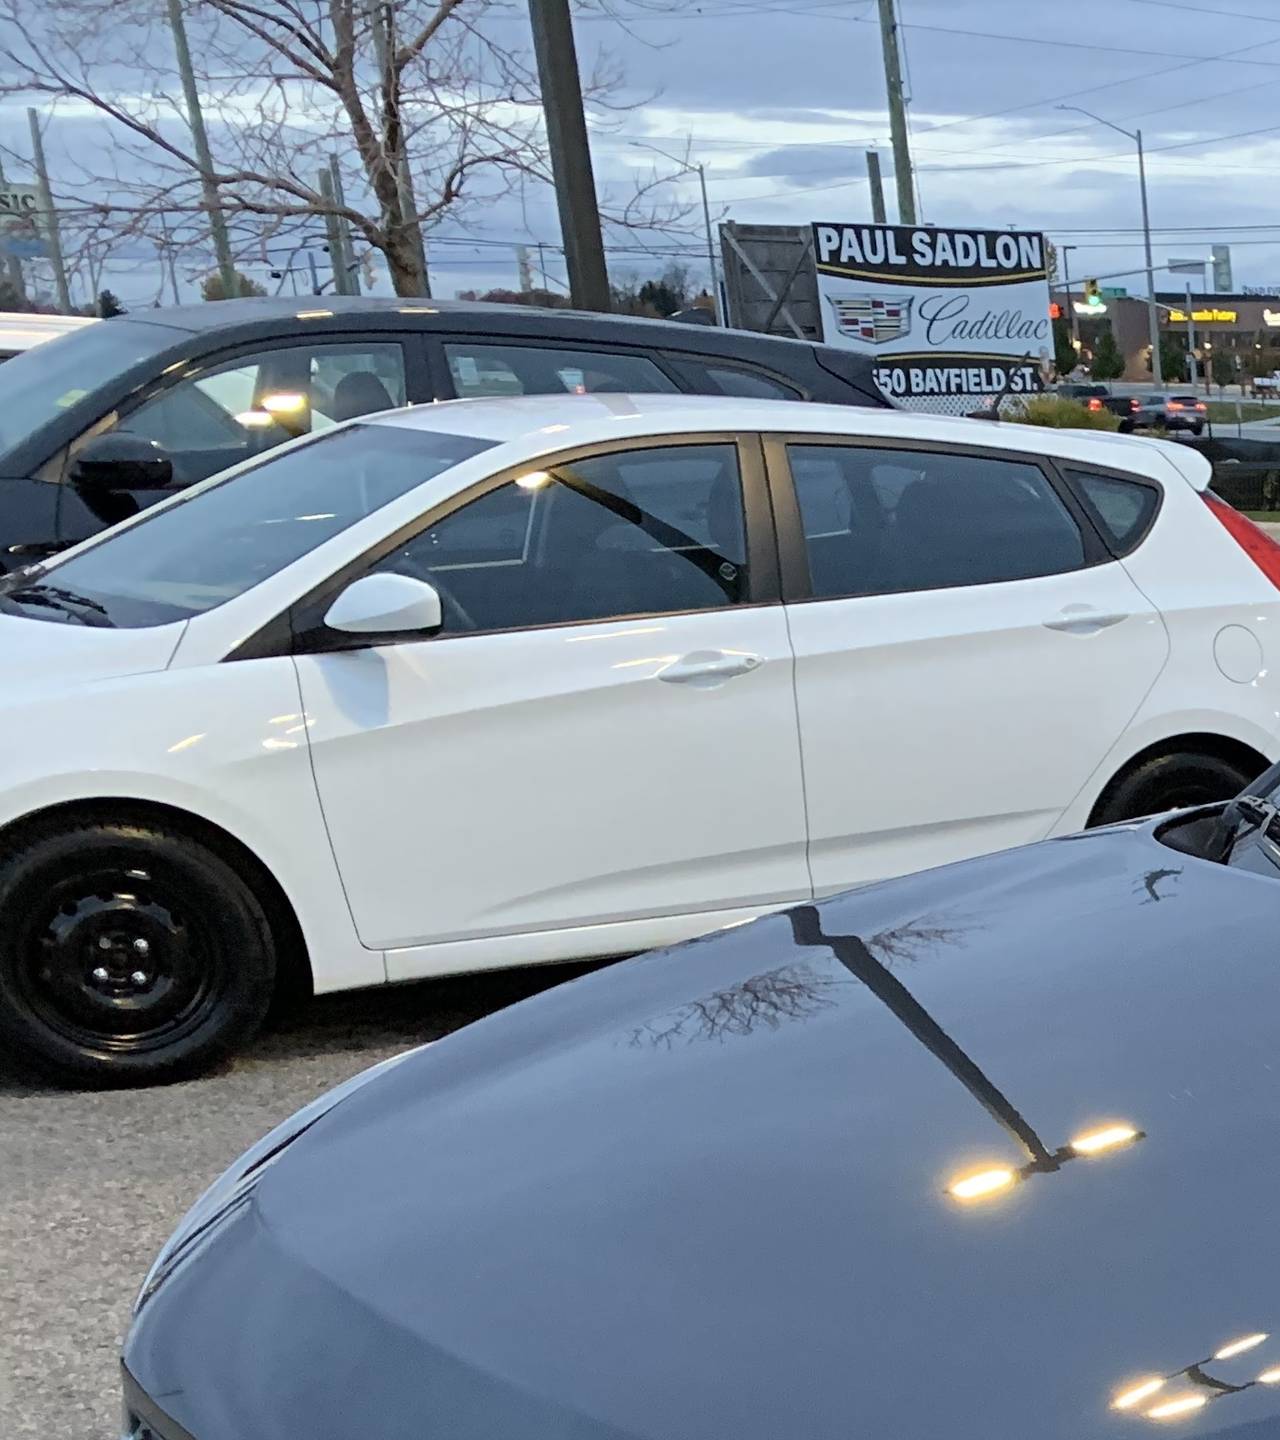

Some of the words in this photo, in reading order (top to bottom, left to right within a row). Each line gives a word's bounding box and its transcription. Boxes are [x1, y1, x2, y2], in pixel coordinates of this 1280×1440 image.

[817, 226, 906, 265] PAUL
[911, 231, 1042, 269] SADLON
[918, 294, 1049, 346] Cadillac
[909, 367, 1006, 393] BAYFIELD
[1009, 367, 1038, 391] ST.
